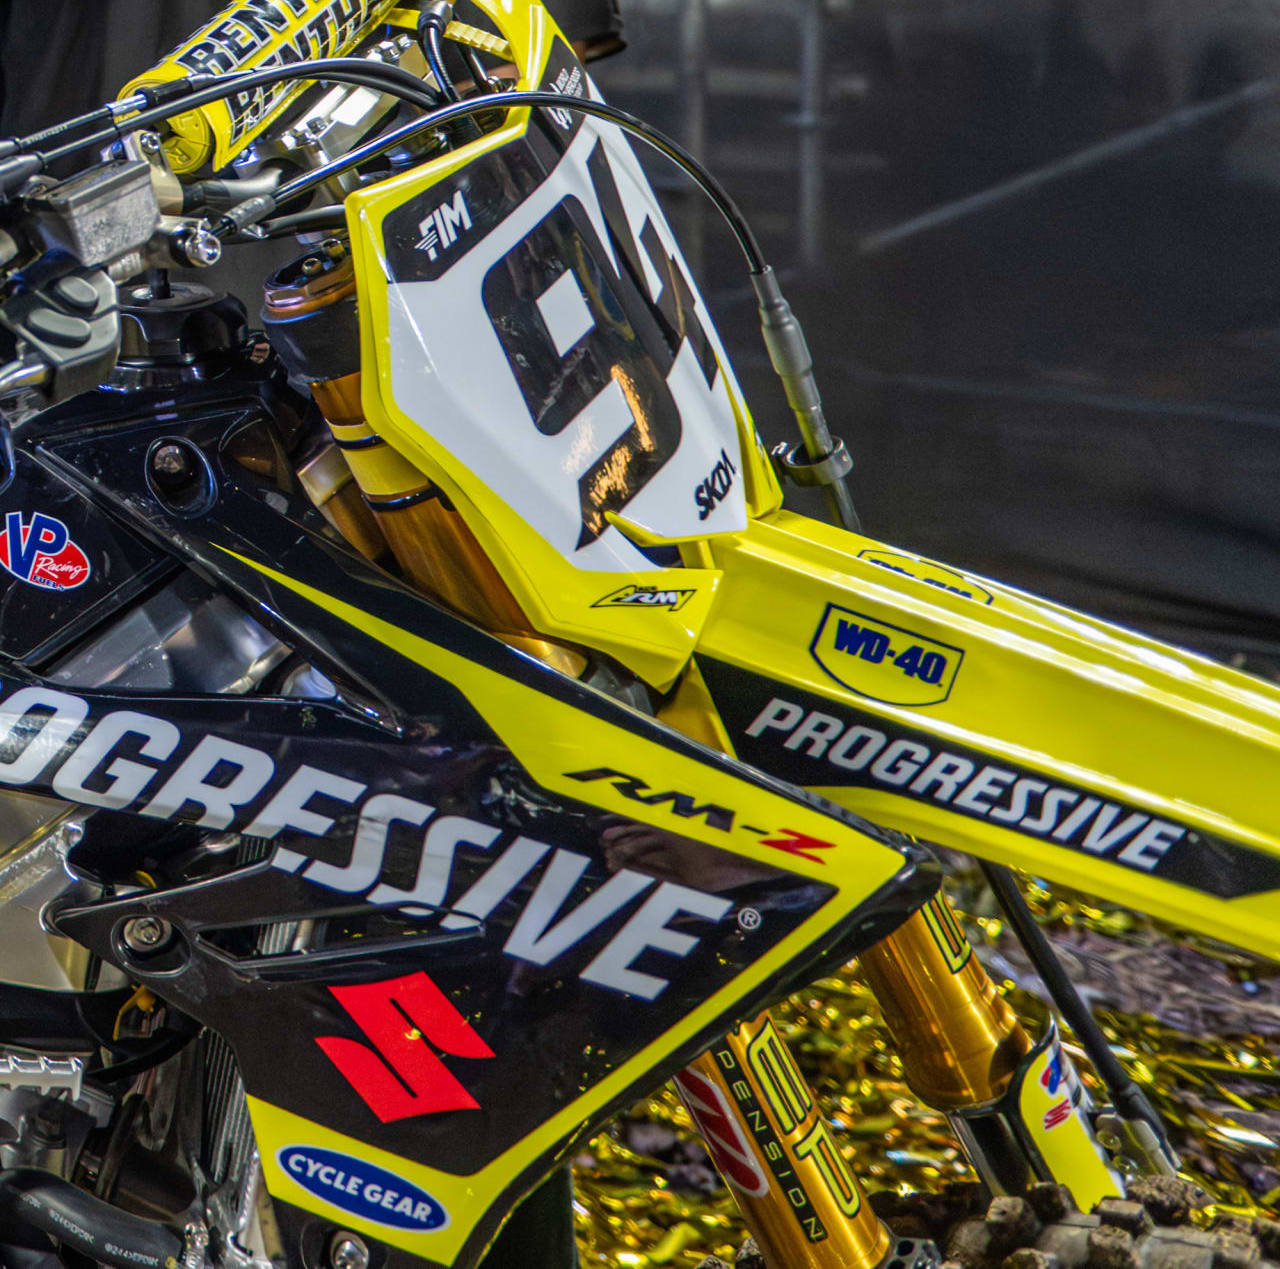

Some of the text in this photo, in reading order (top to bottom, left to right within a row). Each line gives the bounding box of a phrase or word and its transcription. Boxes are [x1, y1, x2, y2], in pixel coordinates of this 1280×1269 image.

[414, 188, 474, 263] FIM
[693, 447, 738, 521] SKDA
[5, 511, 70, 583] VP
[33, 556, 90, 580] Racing
[833, 618, 949, 687] WD-40
[562, 765, 838, 866] RM-Z
[743, 696, 1190, 873] PROGRESSIVE
[716, 1048, 827, 1242] PENSION
[286, 1151, 442, 1229] CYCLE GEAR
